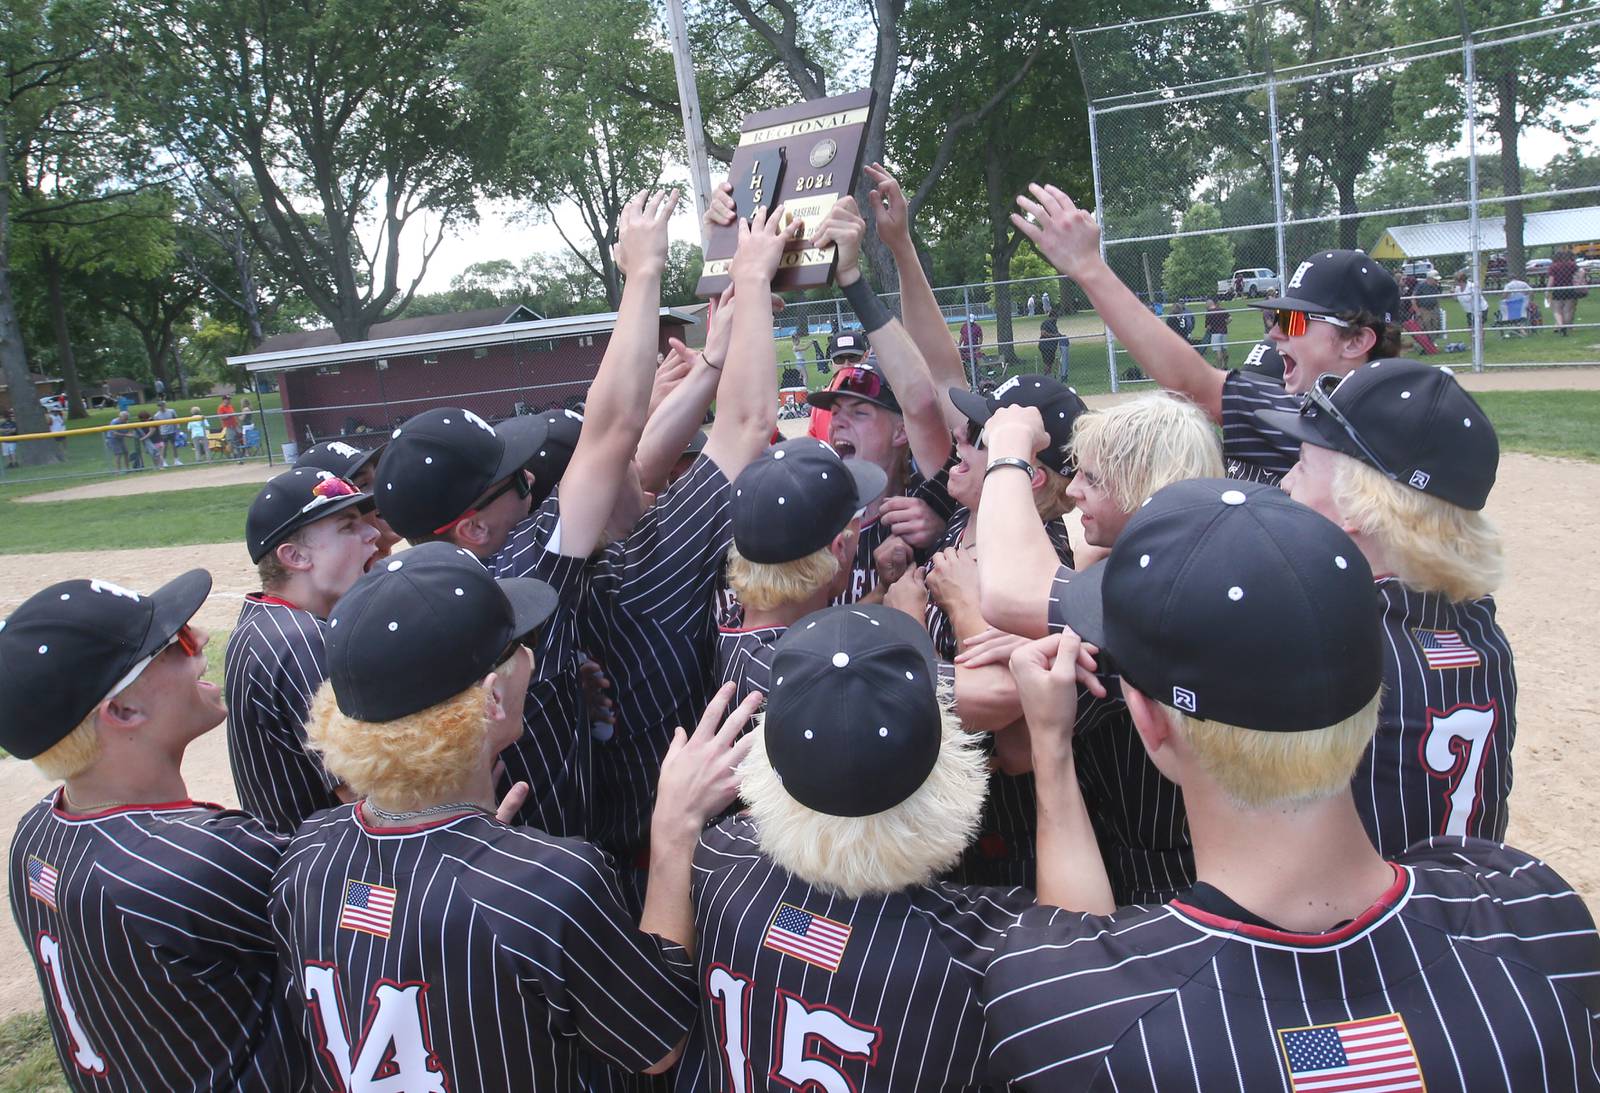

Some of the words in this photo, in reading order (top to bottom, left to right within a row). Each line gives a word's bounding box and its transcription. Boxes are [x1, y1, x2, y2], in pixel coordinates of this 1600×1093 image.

[753, 114, 852, 142] REGIONAL
[795, 172, 834, 192] 2024
[1288, 261, 1314, 289] H
[1243, 343, 1272, 366] H
[1418, 698, 1498, 838] 7
[36, 929, 110, 1078] 1
[304, 960, 450, 1093] 14
[705, 961, 883, 1093] 15
